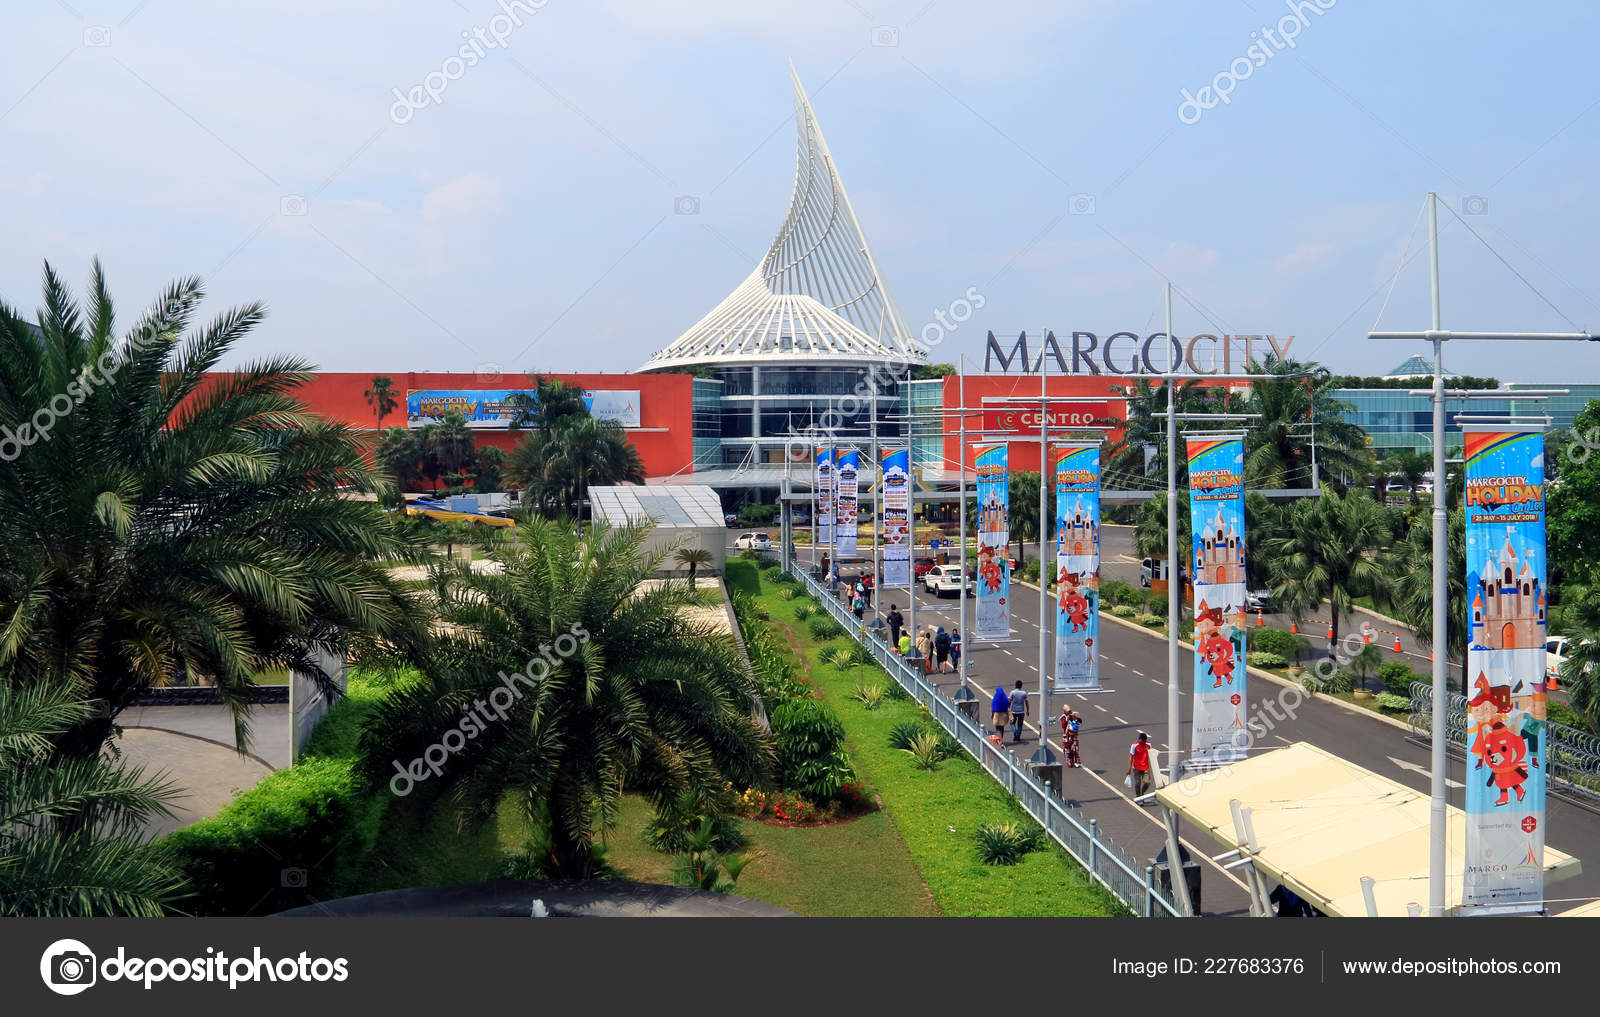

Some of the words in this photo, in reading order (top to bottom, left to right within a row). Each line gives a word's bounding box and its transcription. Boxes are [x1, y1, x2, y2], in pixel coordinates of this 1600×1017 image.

[984, 330, 1296, 376] MARGOCITY
[1020, 413, 1095, 425] CENTRO
[1057, 473, 1099, 484] HOLIDAY
[1190, 469, 1232, 477] MARGOCITY
[1190, 474, 1243, 490] HOLIDAY
[1466, 476, 1527, 487] MARGOCITY
[1466, 484, 1544, 506] HOLIDAY
[1468, 864, 1508, 873] MARGO
